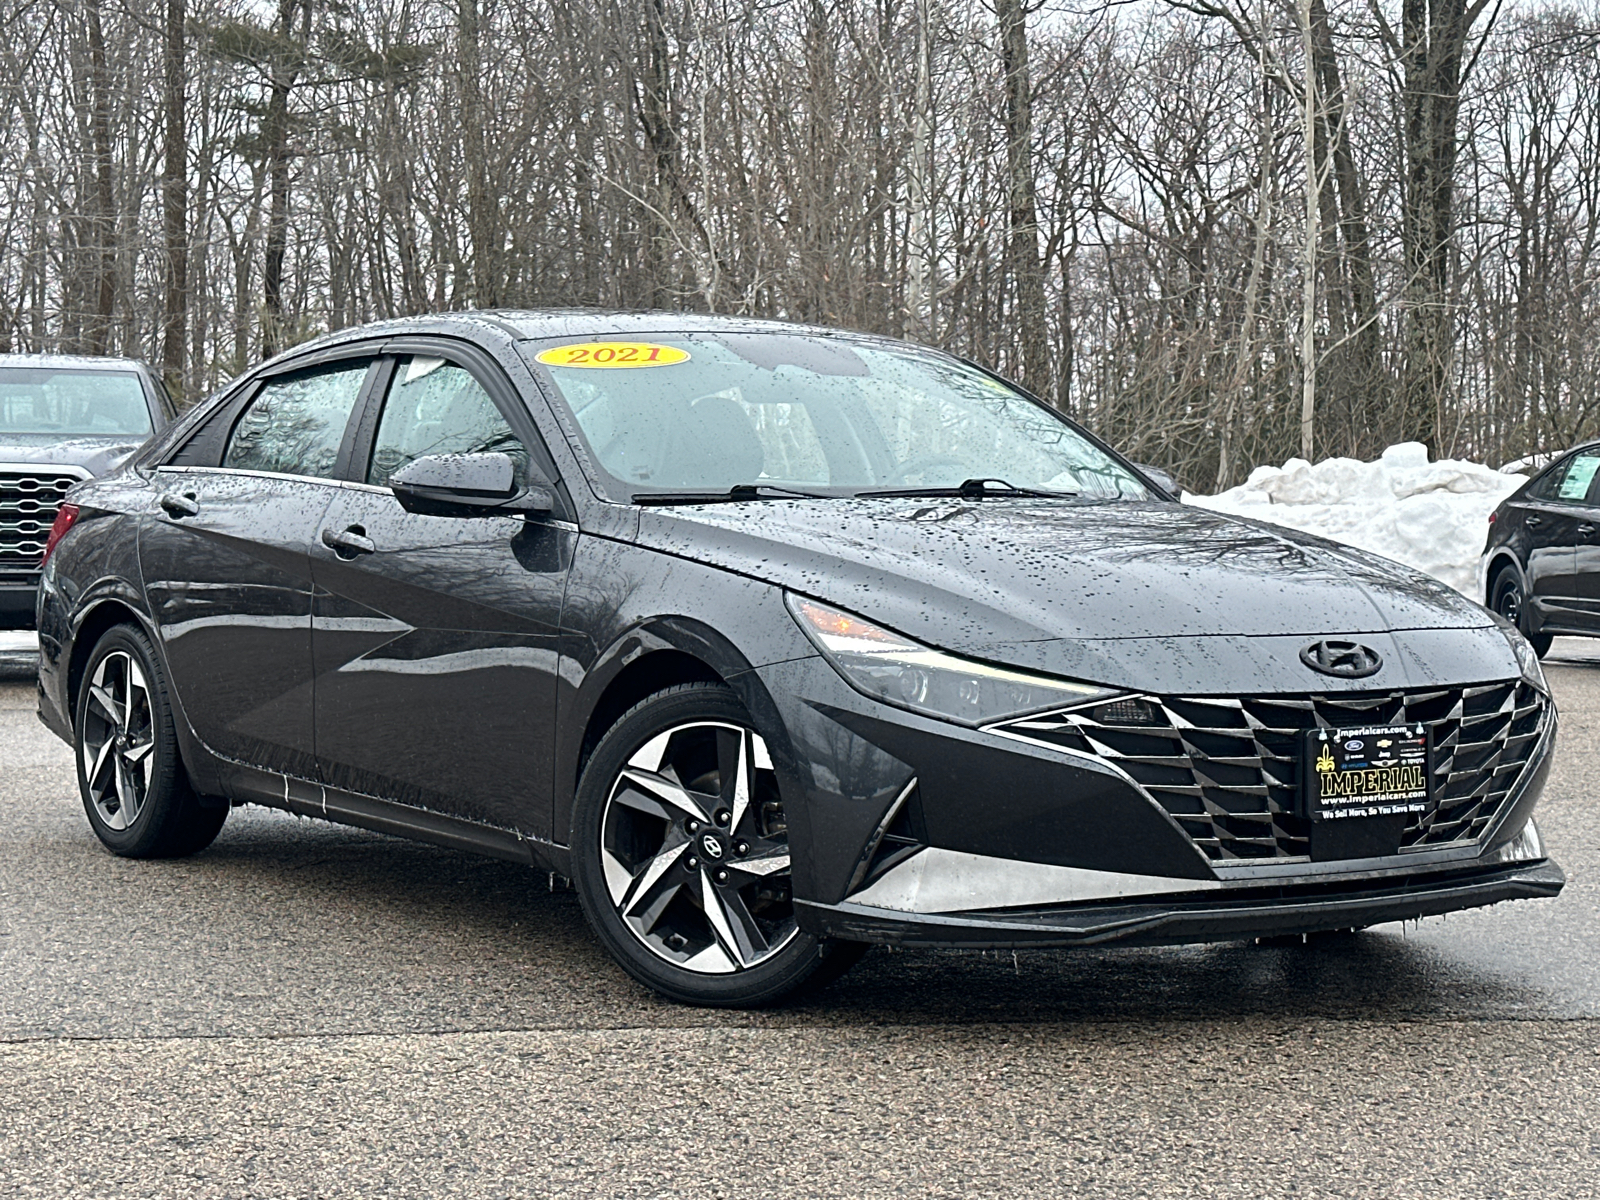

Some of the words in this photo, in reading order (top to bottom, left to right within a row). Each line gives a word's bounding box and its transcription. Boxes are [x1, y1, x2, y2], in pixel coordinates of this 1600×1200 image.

[566, 347, 661, 363] 2021
[1320, 765, 1426, 797] IMPERIAL
[1320, 790, 1426, 805] www.imperialcars.com
[1322, 811, 1334, 819] We
[1335, 809, 1347, 818] Sell
[1348, 809, 1367, 817] More,
[1368, 807, 1378, 815] So
[1378, 806, 1391, 814] You
[1392, 805, 1408, 813] Save
[1408, 804, 1425, 812] More
